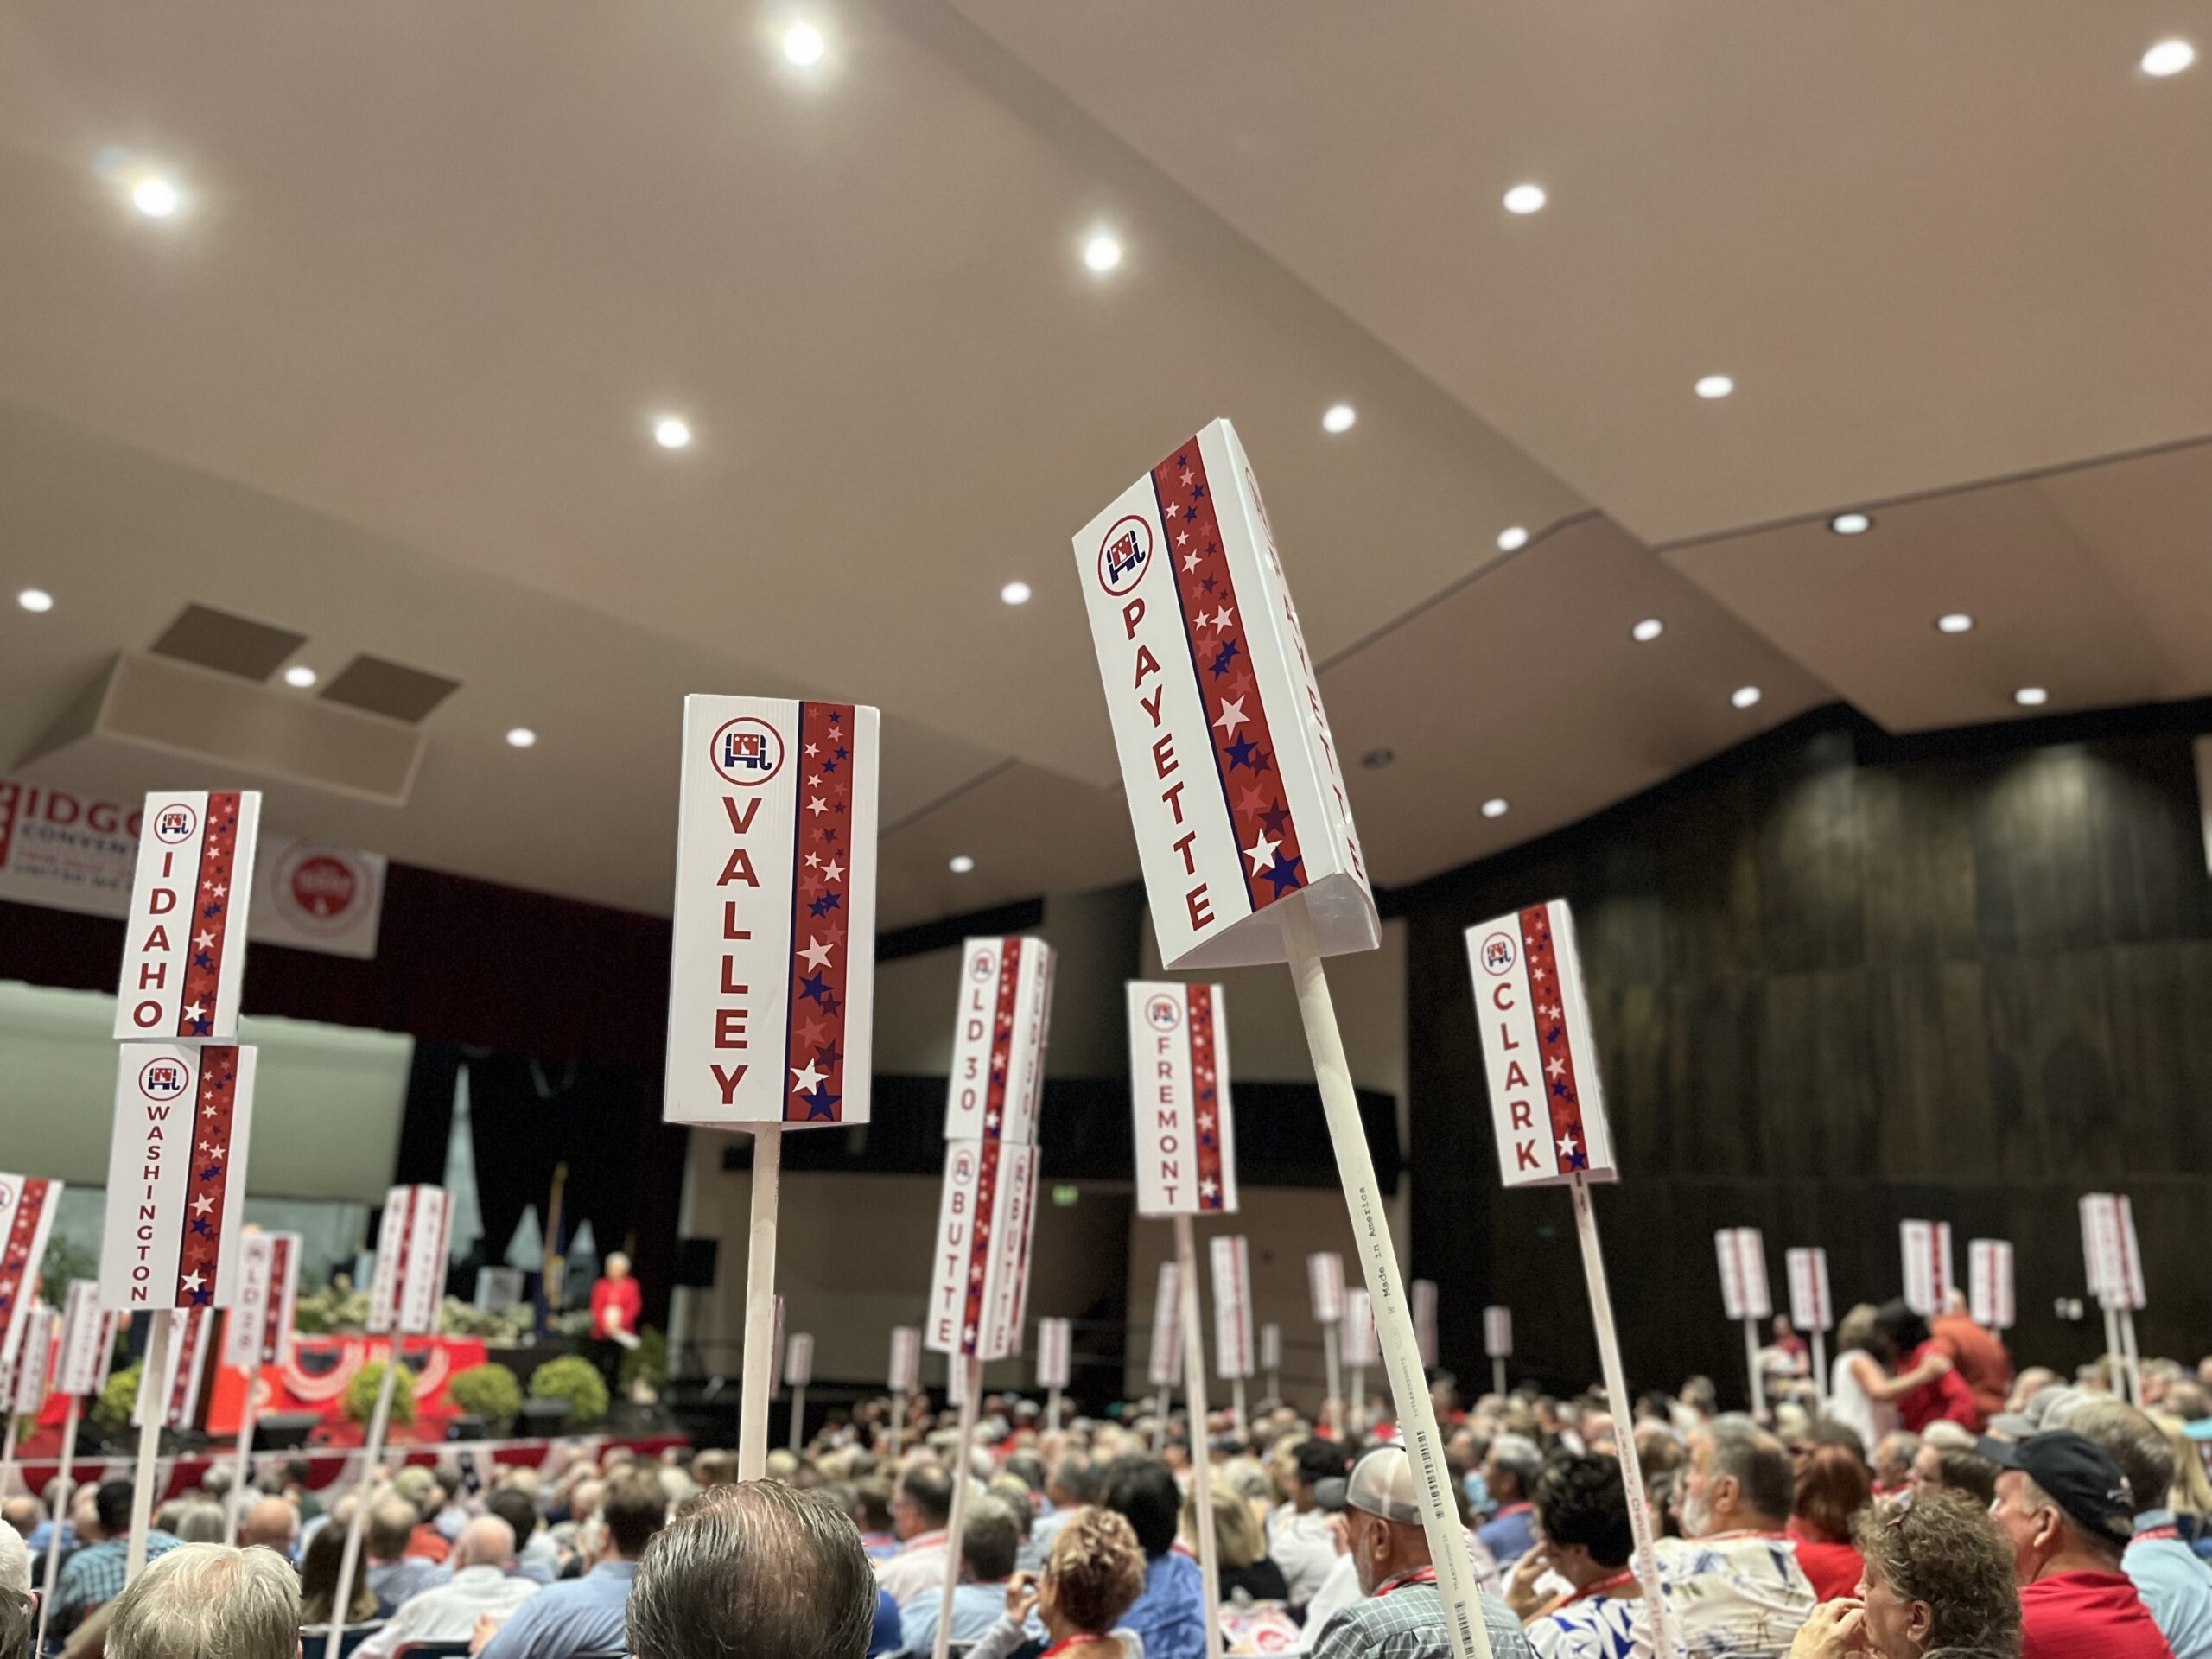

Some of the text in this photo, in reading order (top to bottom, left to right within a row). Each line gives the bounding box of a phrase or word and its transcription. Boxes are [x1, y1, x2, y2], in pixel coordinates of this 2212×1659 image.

[1122, 597, 1216, 932] PAYETTE
[132, 851, 177, 1028] IDAHO
[709, 796, 763, 1105] VALLEY
[960, 989, 984, 1111] LD 30
[1156, 1037, 1179, 1205] FREMONT
[1491, 982, 1541, 1172] CLARK
[130, 1106, 171, 1301] WASHINGTON
[938, 1191, 965, 1343] BUTTE
[1359, 1187, 1391, 1298] Made in America
